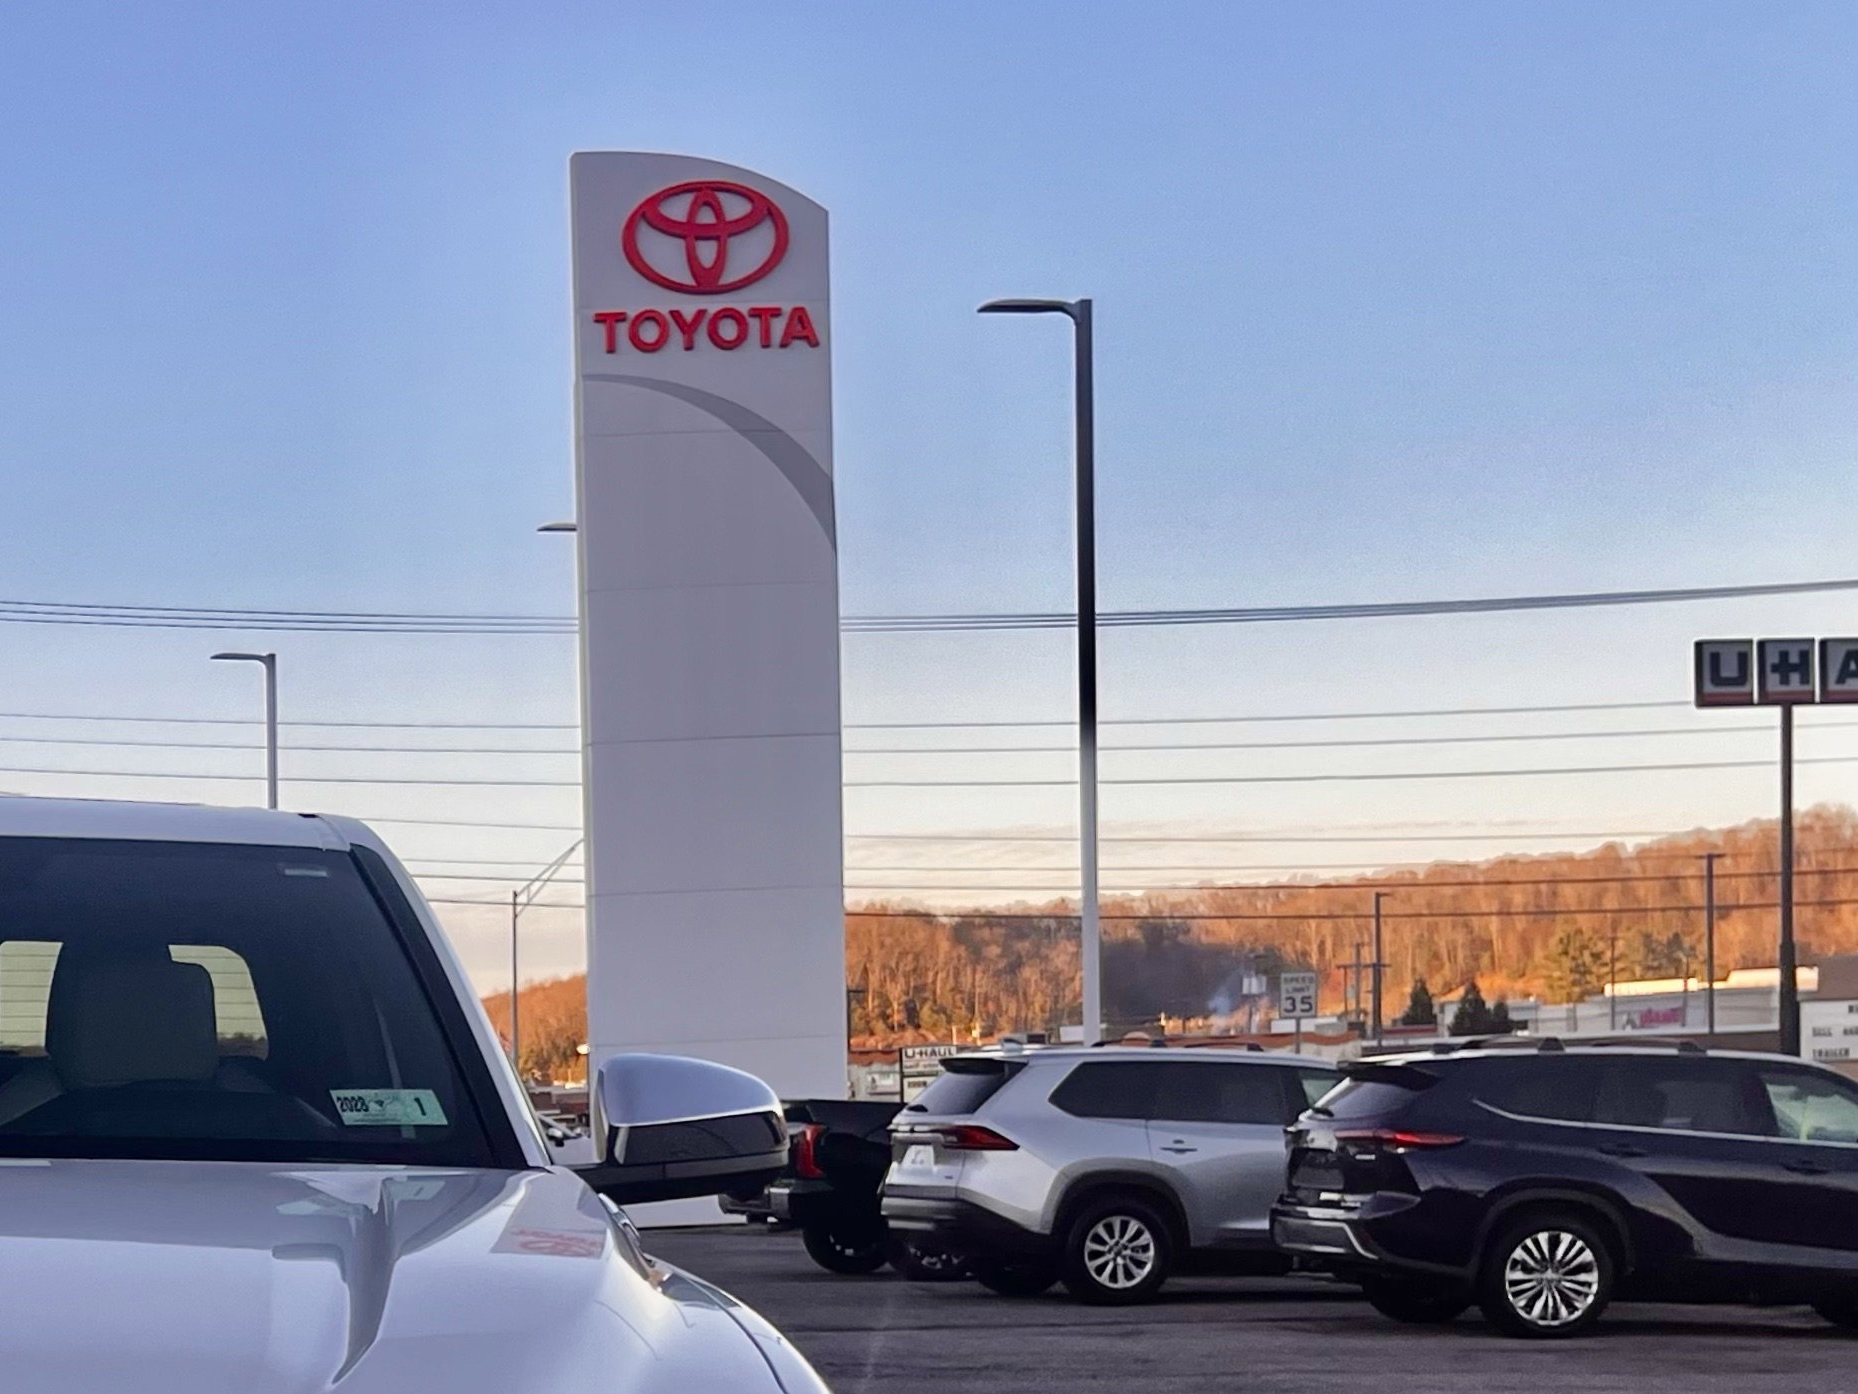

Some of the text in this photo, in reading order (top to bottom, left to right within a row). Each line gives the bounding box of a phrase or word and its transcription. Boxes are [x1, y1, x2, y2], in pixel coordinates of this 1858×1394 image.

[594, 307, 820, 354] TOYOTA
[1284, 995, 1313, 1013] 35
[413, 1097, 427, 1117] 1
